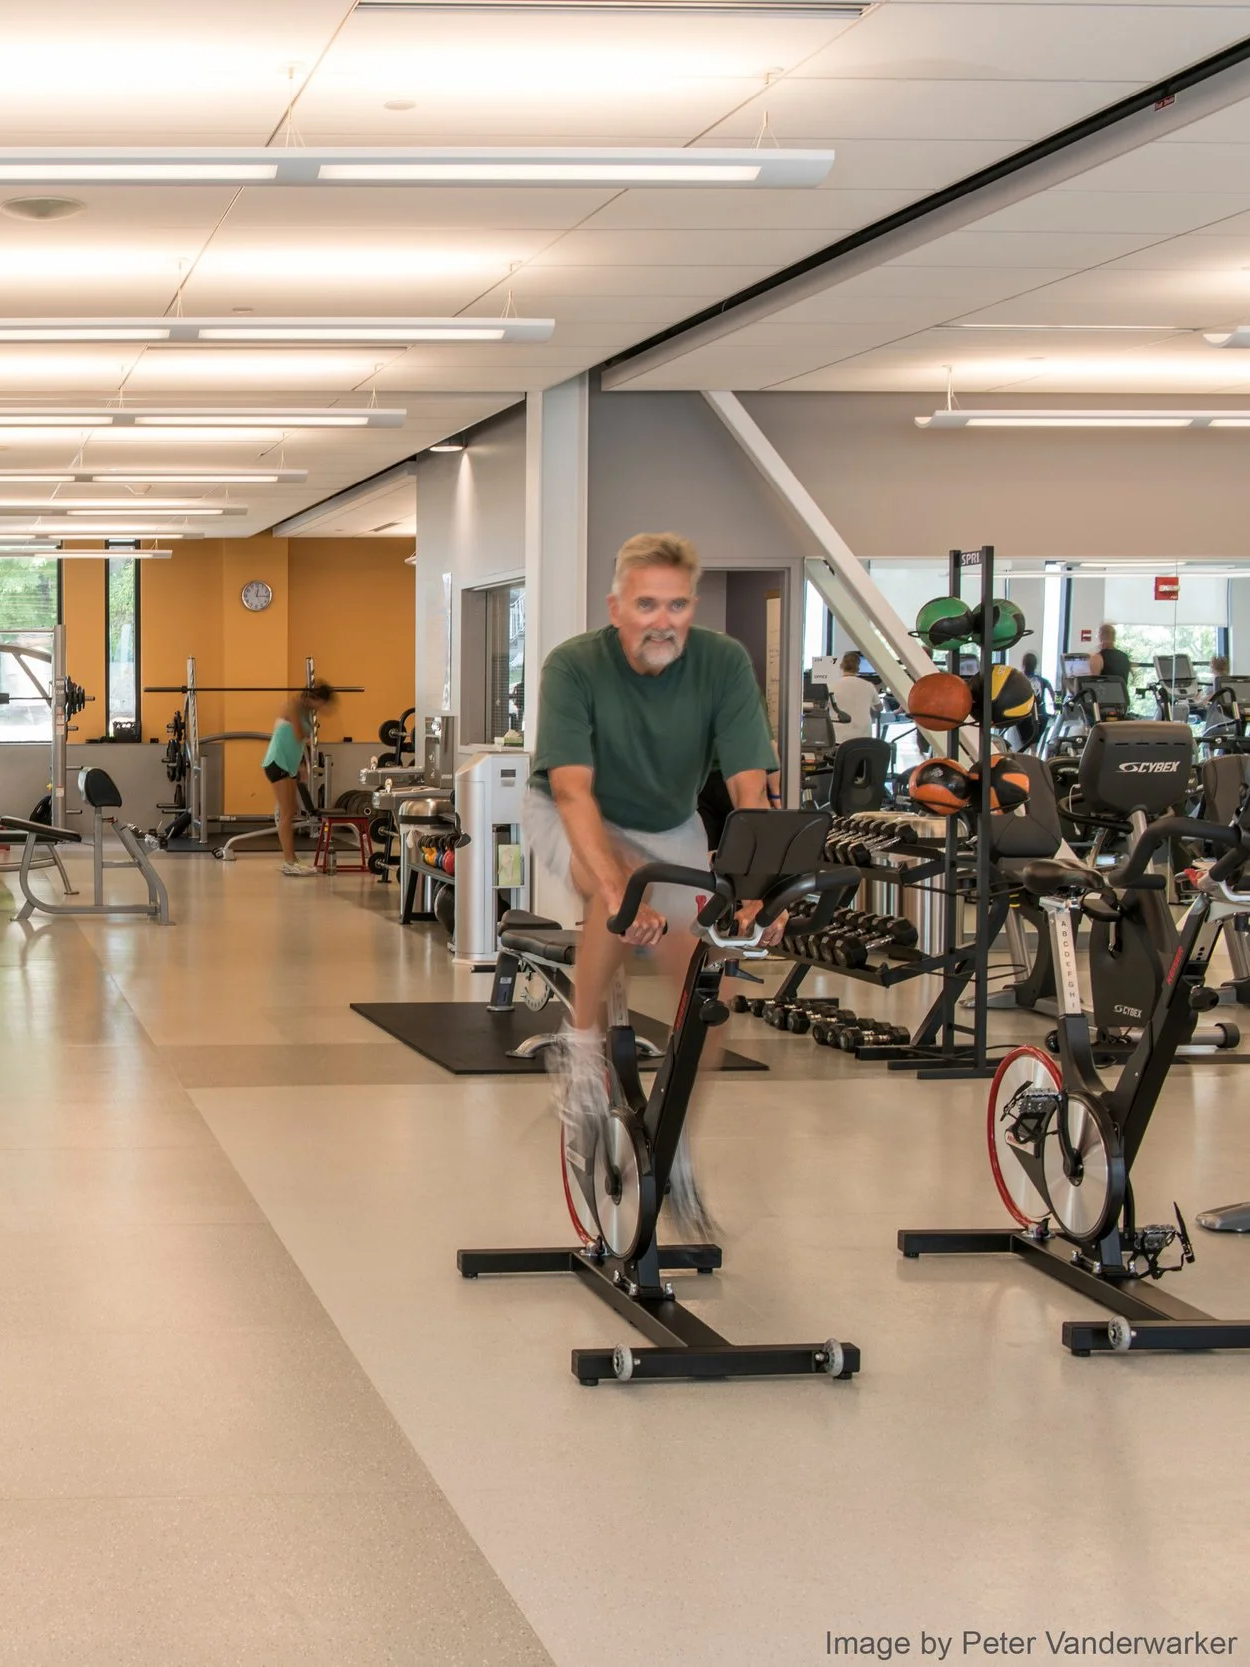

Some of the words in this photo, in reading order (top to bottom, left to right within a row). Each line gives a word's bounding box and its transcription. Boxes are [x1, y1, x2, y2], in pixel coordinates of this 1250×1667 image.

[961, 552, 980, 566] SPRI
[1137, 761, 1181, 773] CYBEX
[1122, 1006, 1143, 1019] CYBEX
